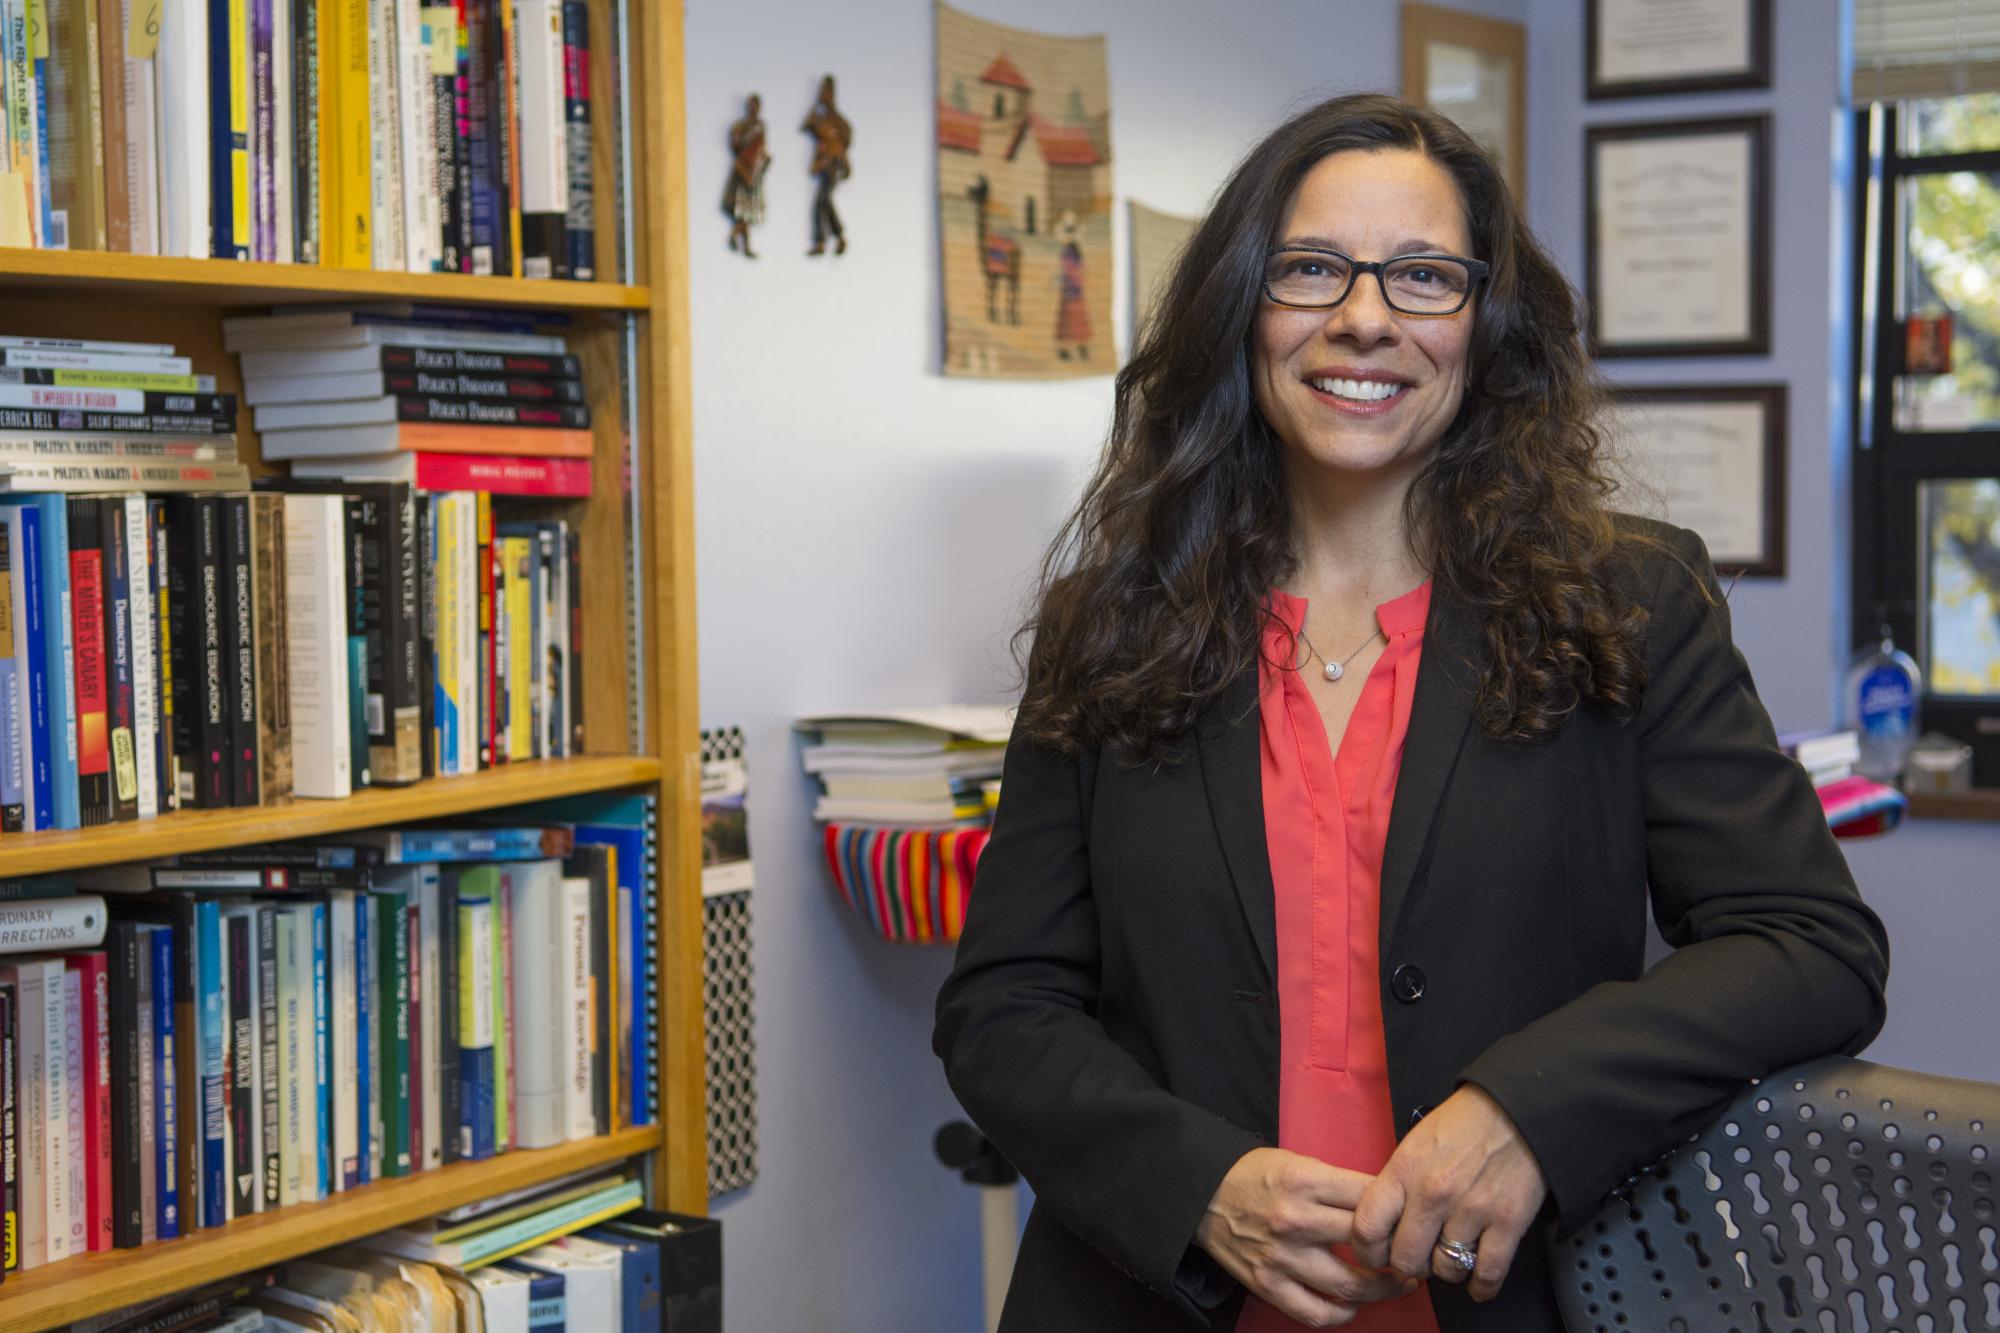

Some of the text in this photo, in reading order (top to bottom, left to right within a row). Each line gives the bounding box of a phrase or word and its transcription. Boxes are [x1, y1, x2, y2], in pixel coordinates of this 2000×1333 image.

[14, 16, 24, 41] The
[14, 46, 26, 83] Right
[19, 88, 28, 102] to
[20, 106, 29, 126] Be
[33, 411, 53, 429] BELL
[87, 413, 111, 430] SILENT
[129, 509, 149, 725] THE UNDESERVING POOR
[204, 565, 217, 647] DEMOCRATIC
[236, 564, 250, 645] DEMOCRATIC
[402, 551, 416, 620] CYCLE
[77, 558, 99, 700] THE MINER'S CANARY
[114, 599, 128, 681] Democracy and
[207, 649, 220, 723] EDUCATION
[240, 648, 253, 722] EDUCATION
[96, 971, 110, 1087] Capitalist Schools
[574, 914, 587, 1092] Personal Knowledge
[47, 975, 62, 1121] The Spirit of Community
[65, 986, 83, 1161] THE GOOD SOCIETY
[236, 1018, 252, 1088] DEMOCRACY
[33, 1053, 42, 1125] Educational
[142, 1104, 153, 1143] LIGHT
[267, 1156, 278, 1200] USED
